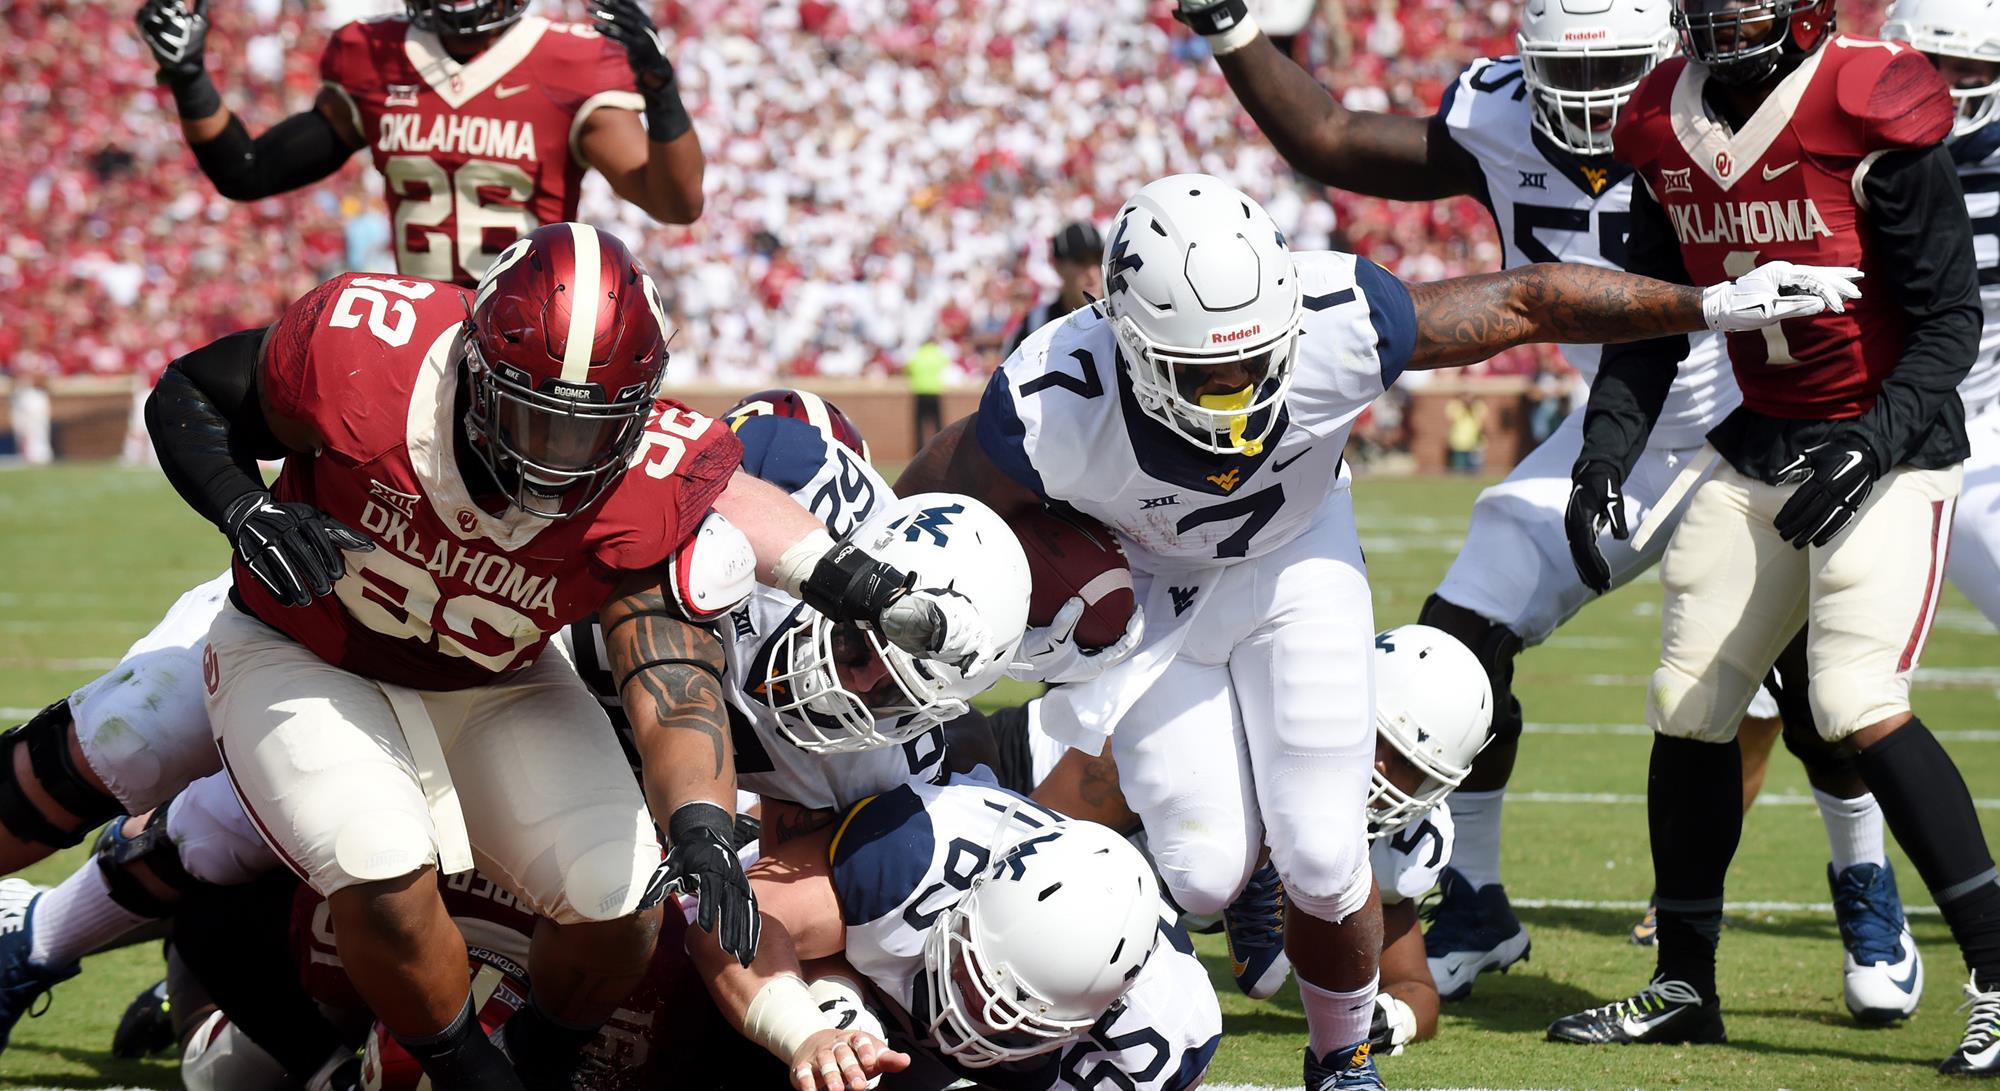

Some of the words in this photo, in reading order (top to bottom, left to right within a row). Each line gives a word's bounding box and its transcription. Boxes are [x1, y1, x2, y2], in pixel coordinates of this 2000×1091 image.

[1565, 31, 1606, 41] Riddell
[378, 112, 537, 161] OKLAHOMA
[1518, 170, 1548, 190] XII
[385, 154, 538, 281] 26
[1667, 199, 1834, 245] OKLAHOMA
[1211, 325, 1261, 344] Riddell
[504, 367, 520, 381] NIKE
[1018, 348, 1105, 400] 7
[554, 385, 591, 400] BOOMER
[1138, 494, 1180, 510] XII
[1177, 483, 1286, 559] 7
[360, 500, 558, 618] OKLAHOMA
[469, 946, 525, 979] SOONER
